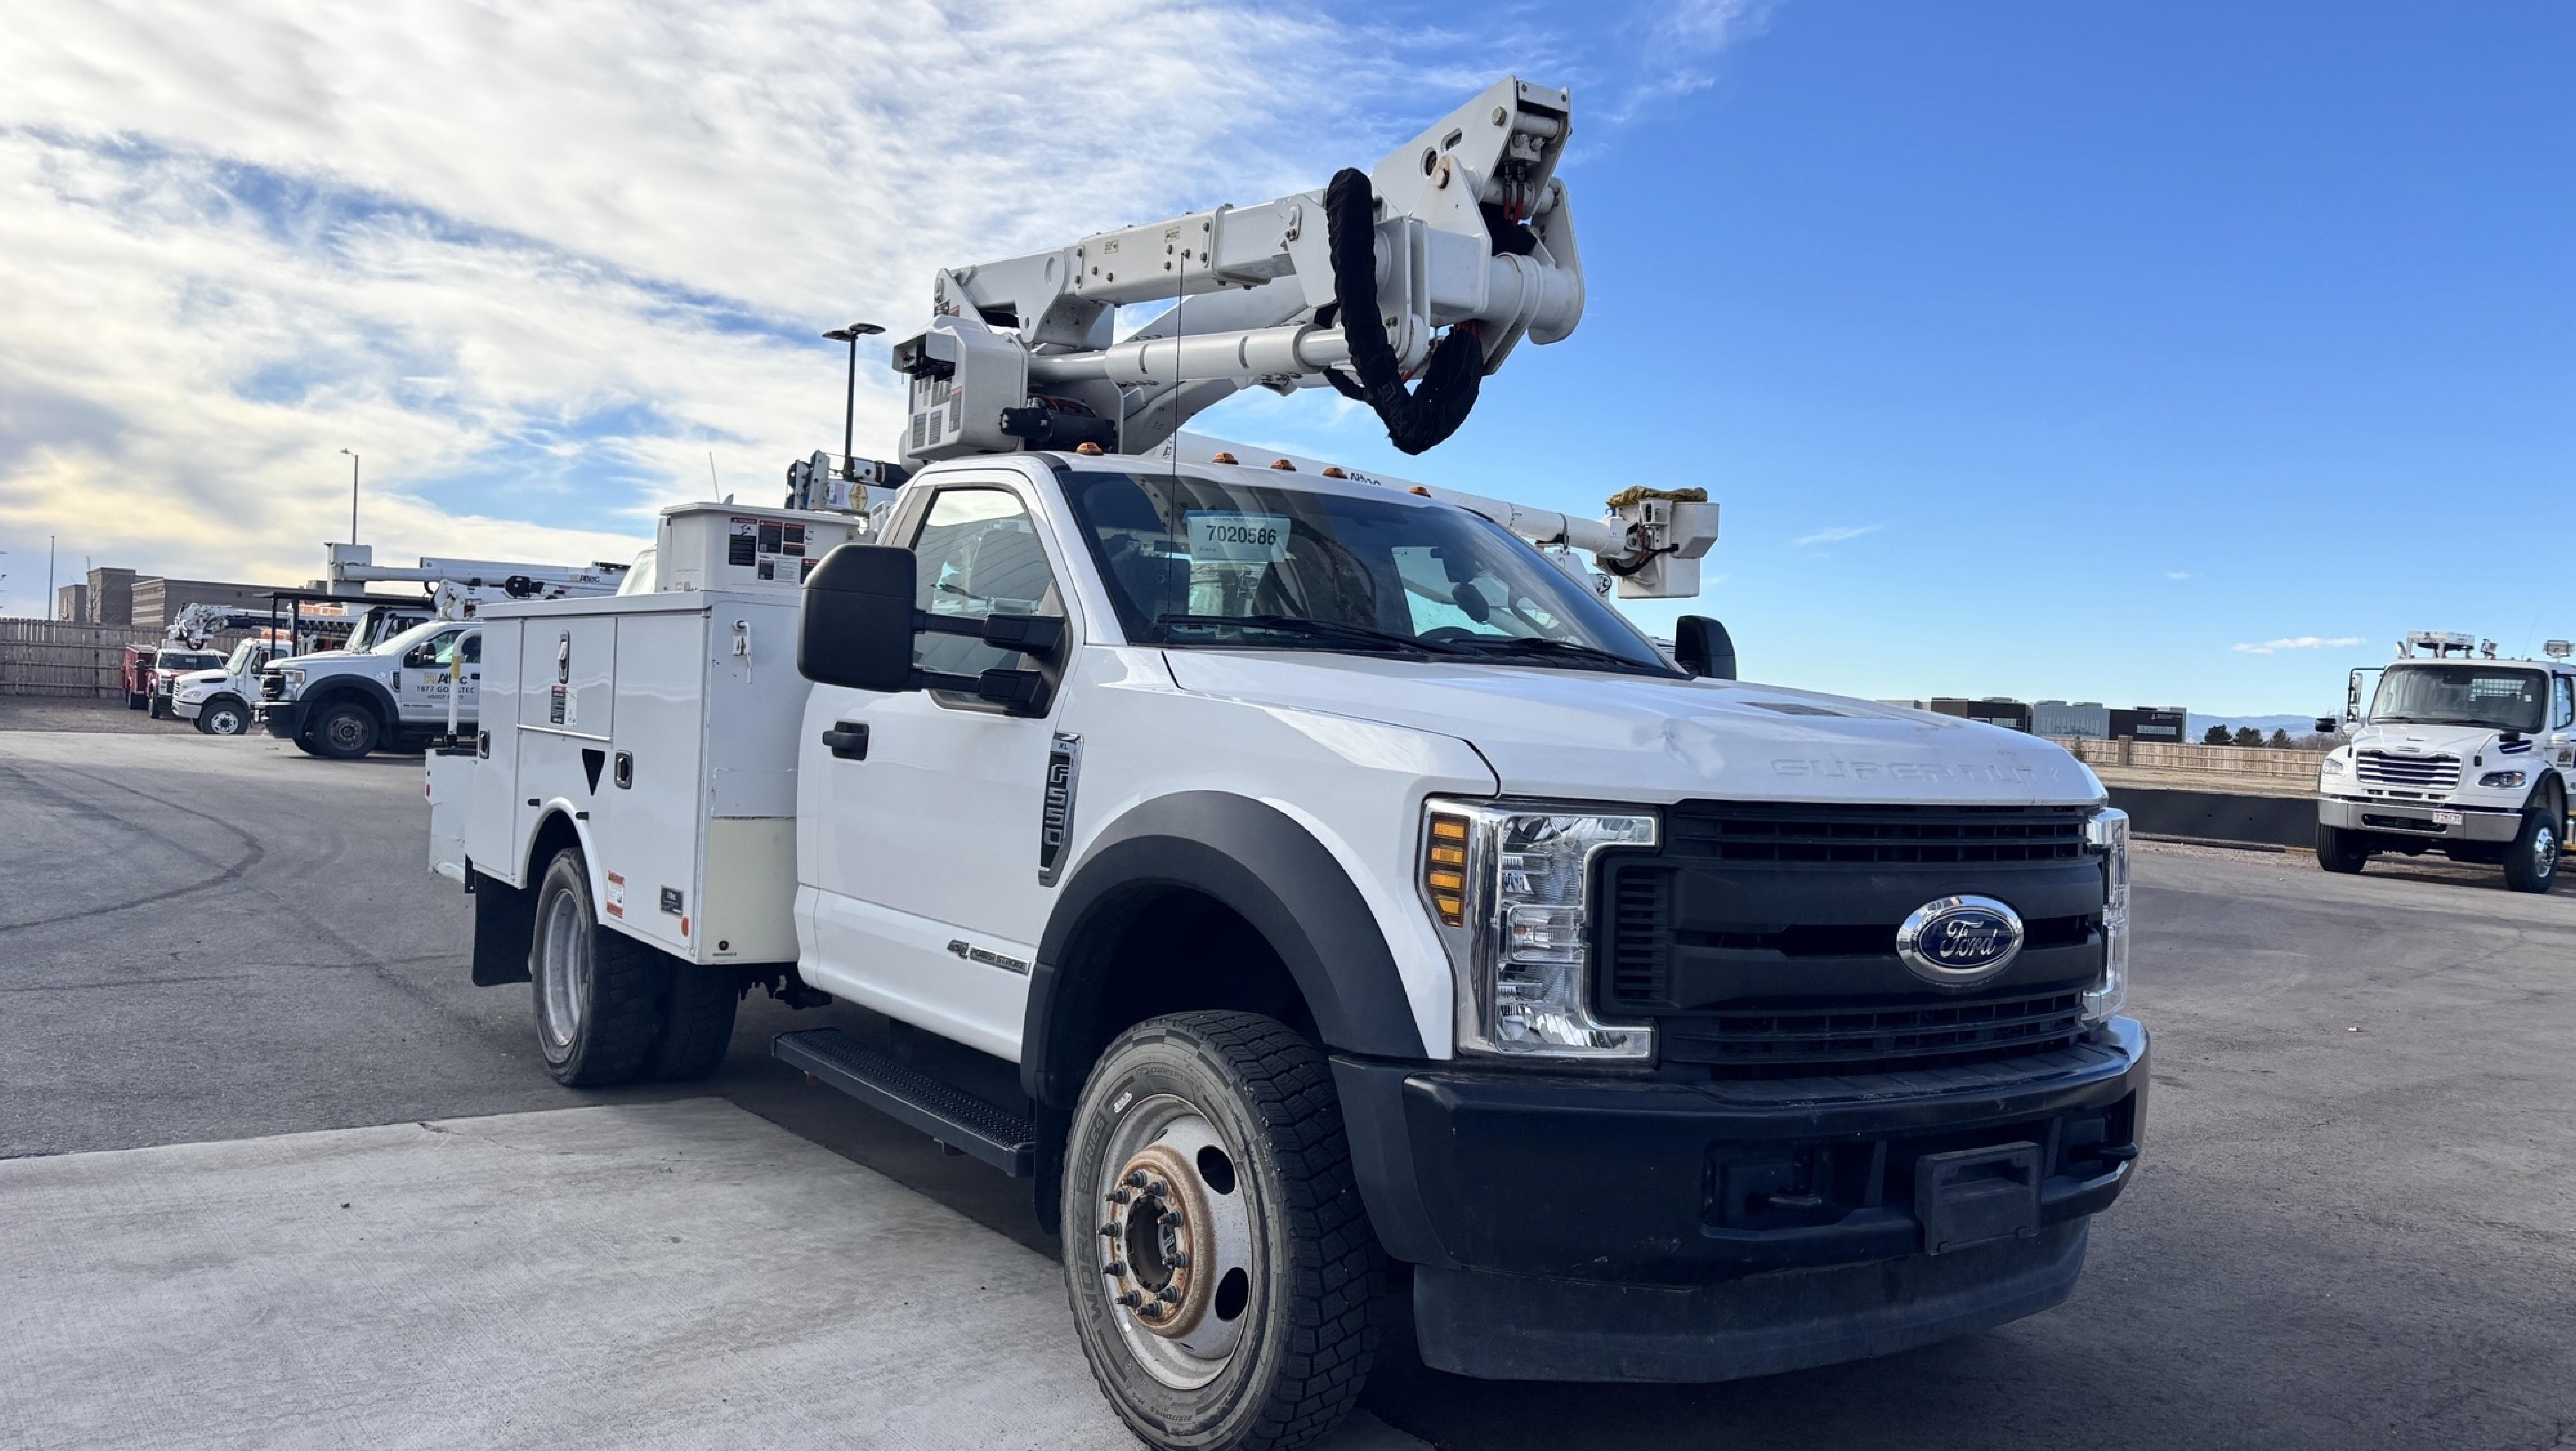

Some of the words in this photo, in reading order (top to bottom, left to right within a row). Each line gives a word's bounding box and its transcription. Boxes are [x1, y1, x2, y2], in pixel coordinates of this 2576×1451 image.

[1206, 525, 1276, 545] 7020586
[438, 673, 467, 684] Alc
[1940, 920, 1998, 958] Ford
[1078, 1117, 1105, 1193] SERIES
[1076, 1215, 1103, 1320] WORK
